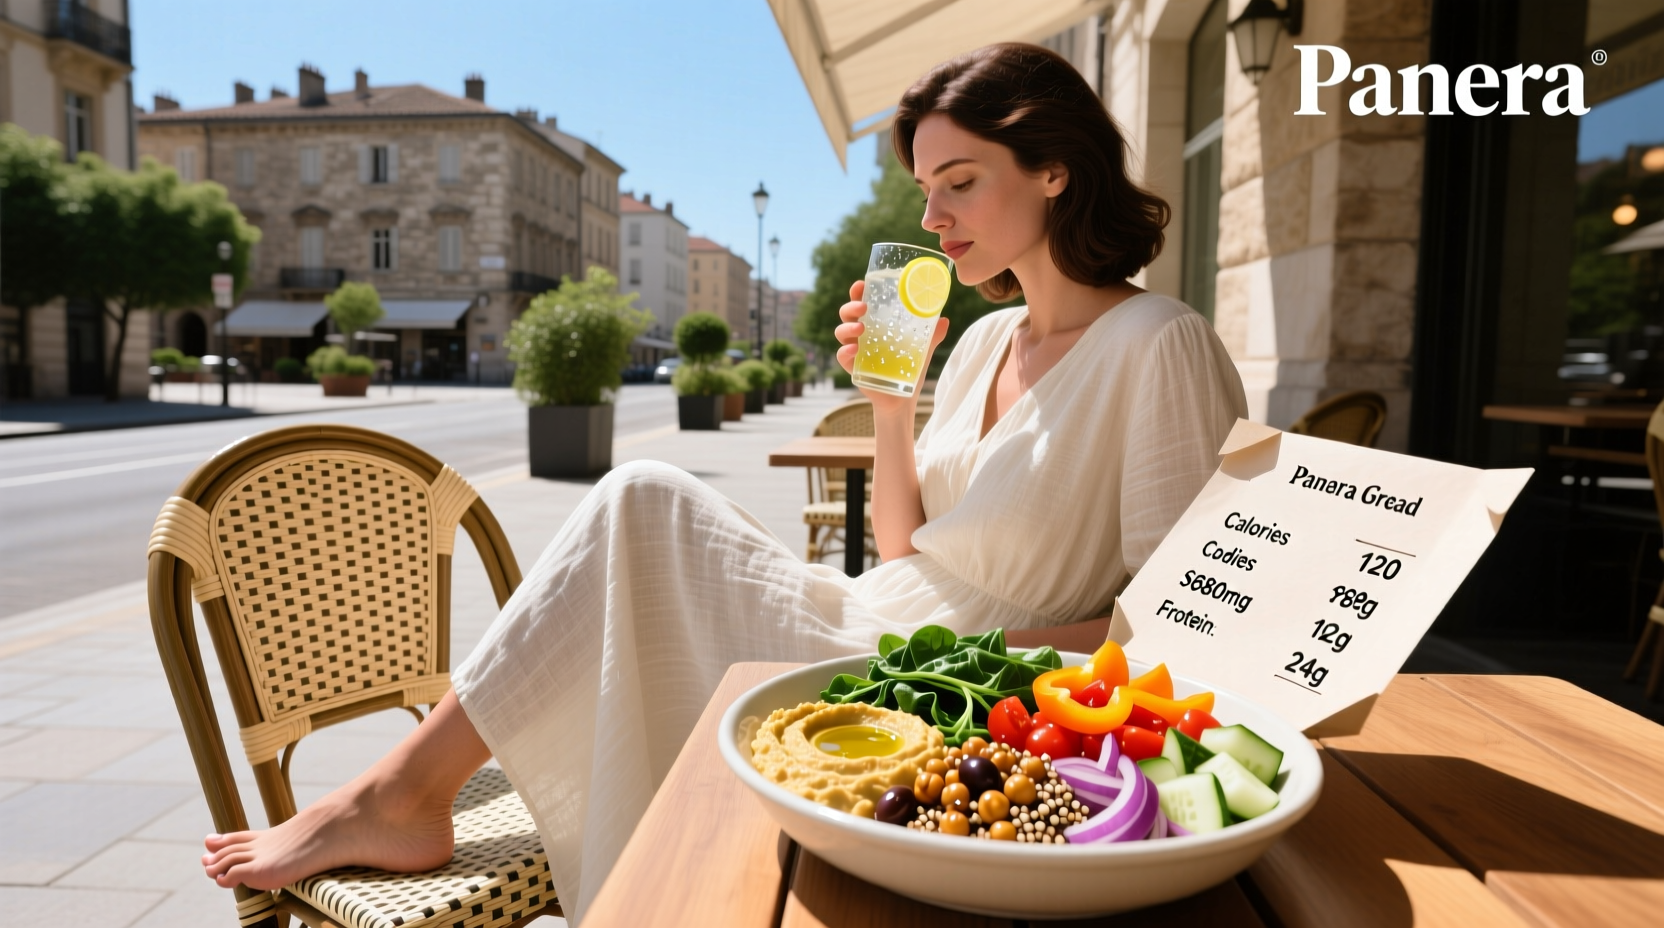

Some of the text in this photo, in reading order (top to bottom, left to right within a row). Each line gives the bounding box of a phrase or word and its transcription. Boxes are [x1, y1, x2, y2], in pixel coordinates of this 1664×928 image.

[1224, 512, 1291, 545] Calories
[1202, 540, 1257, 571] Codies
[1359, 552, 1402, 580] 120
[1311, 619, 1353, 653] 12g
[1284, 651, 1329, 687] 24g
